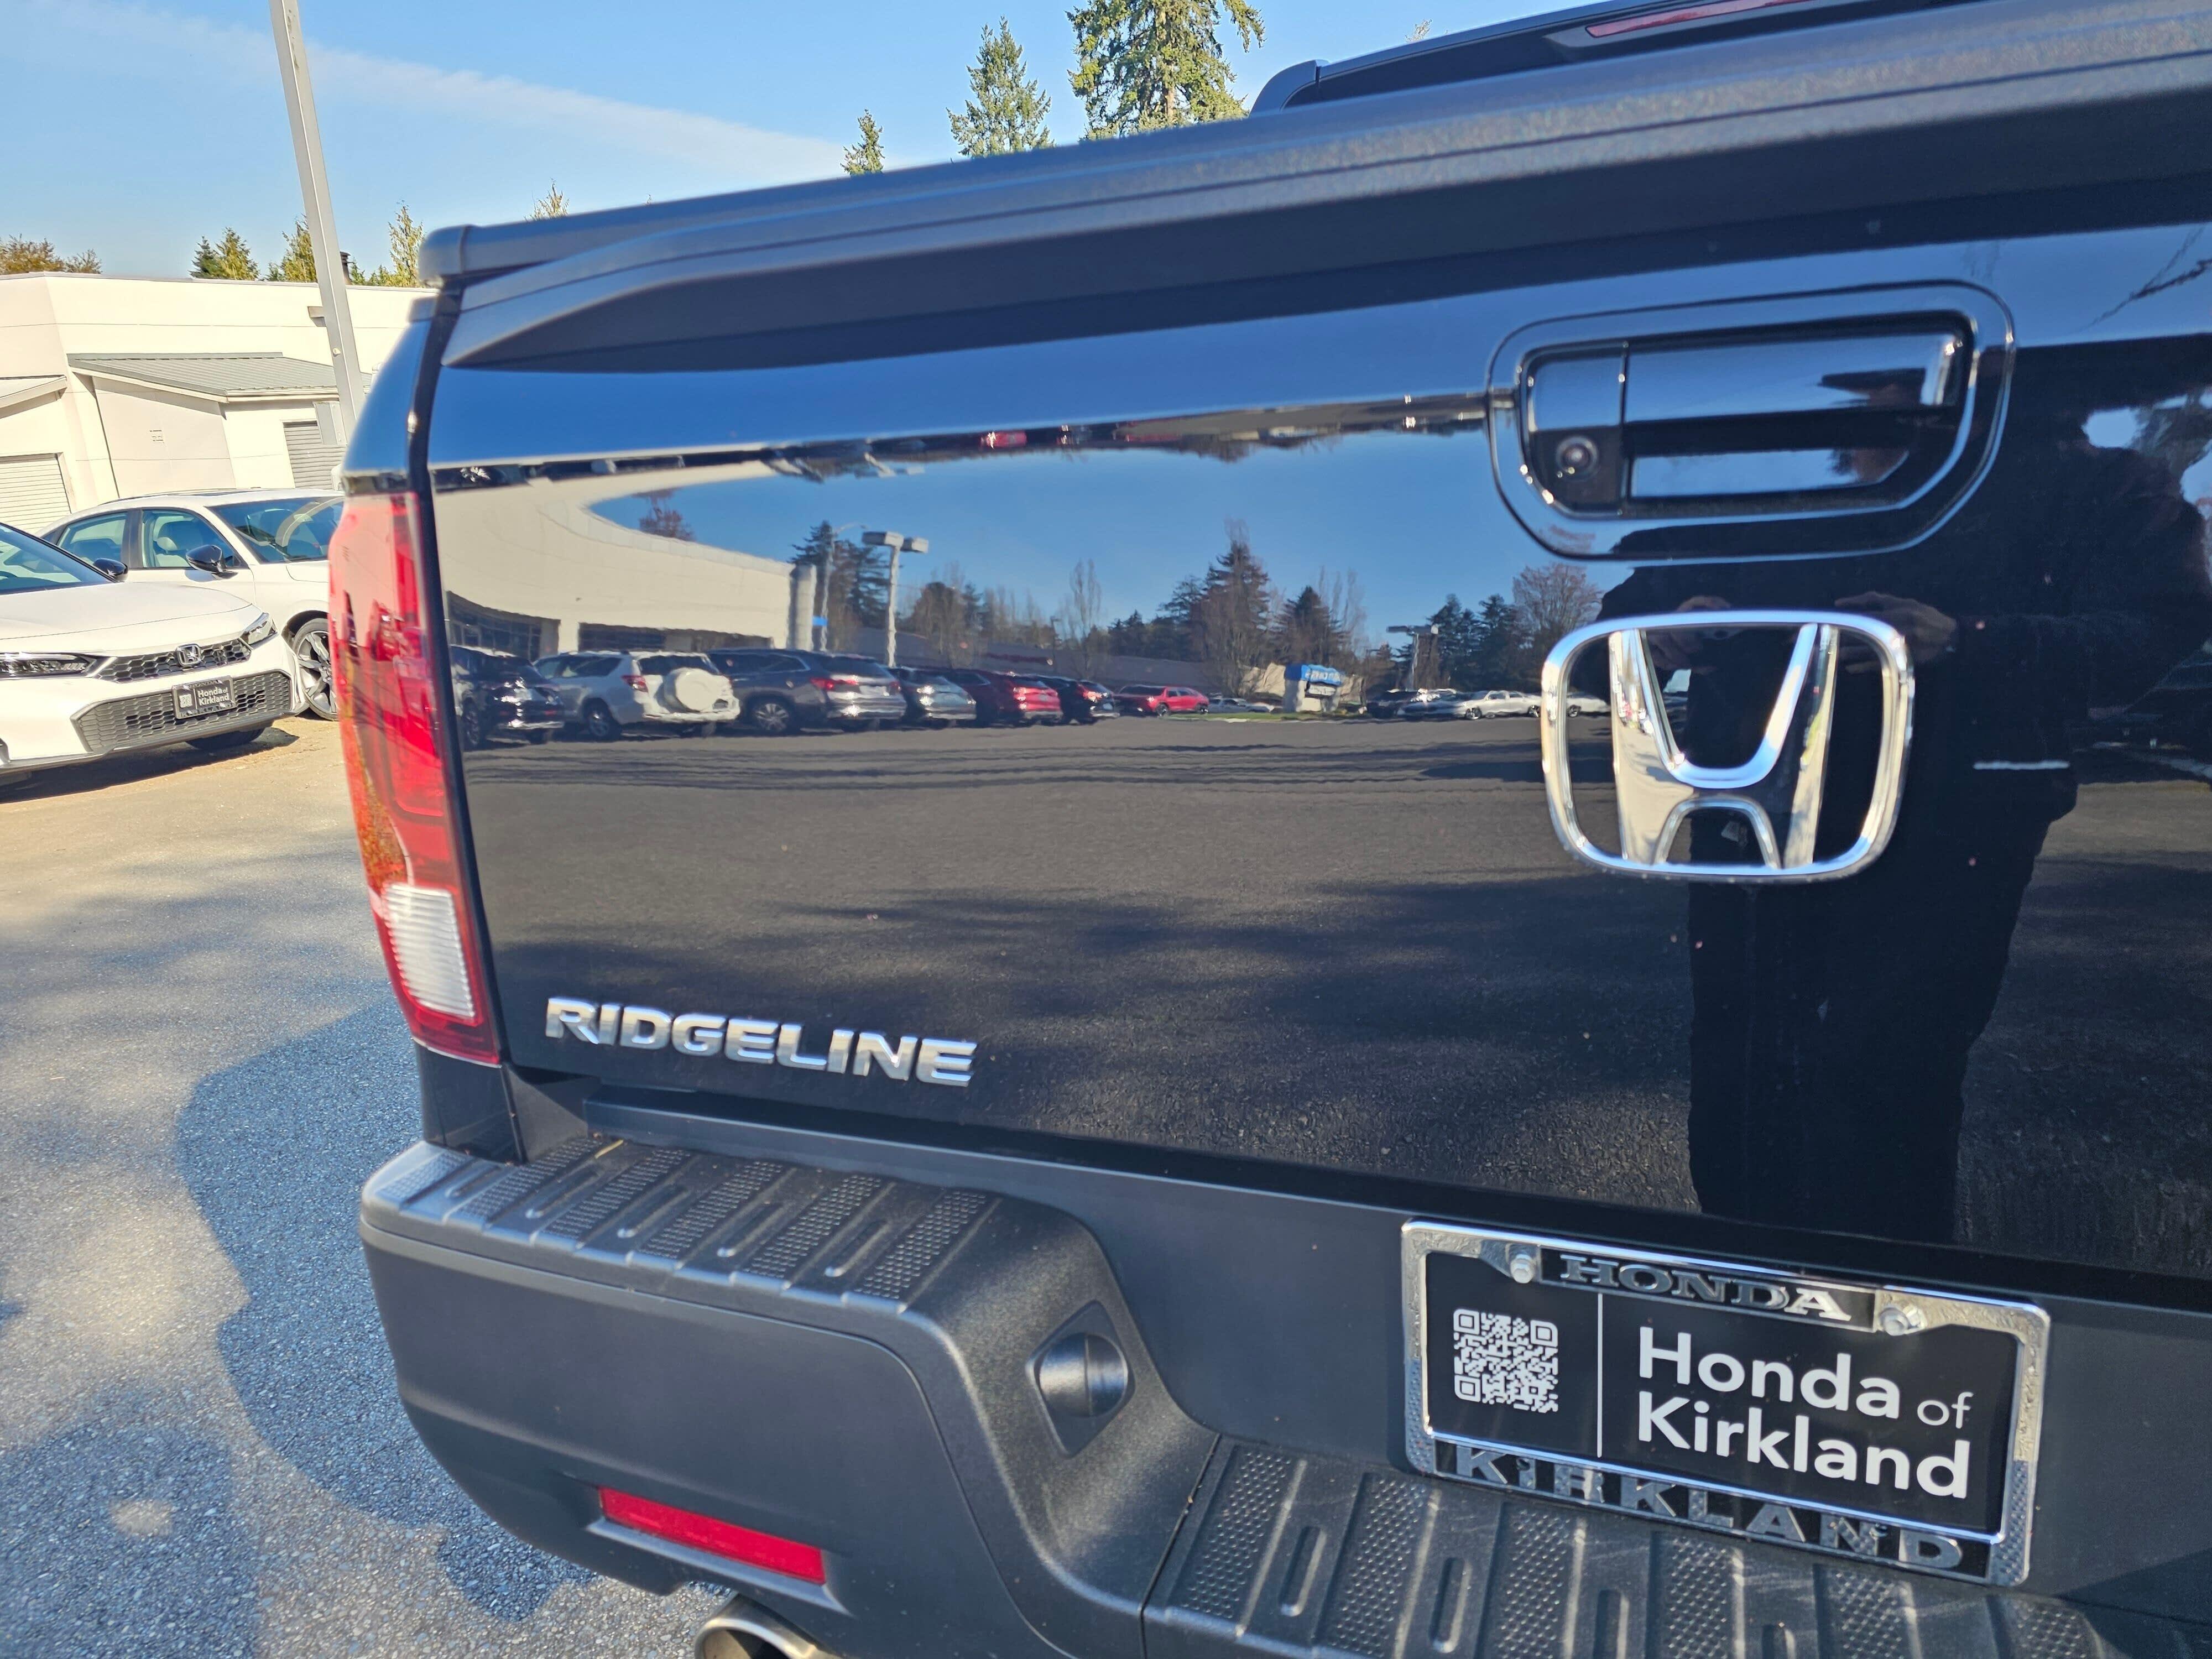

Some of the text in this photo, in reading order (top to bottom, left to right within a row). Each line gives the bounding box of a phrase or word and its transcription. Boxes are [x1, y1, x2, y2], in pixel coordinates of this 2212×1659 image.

[197, 686, 222, 697] Honda
[199, 693, 229, 706] Kirkland
[545, 998, 977, 1087] RIDGELINE
[1560, 1254, 1851, 1321] HONDA
[1639, 1327, 1973, 1429] Honda of
[1638, 1391, 1970, 1499] Kirkland
[1456, 1446, 1963, 1569] KIRKLAND
